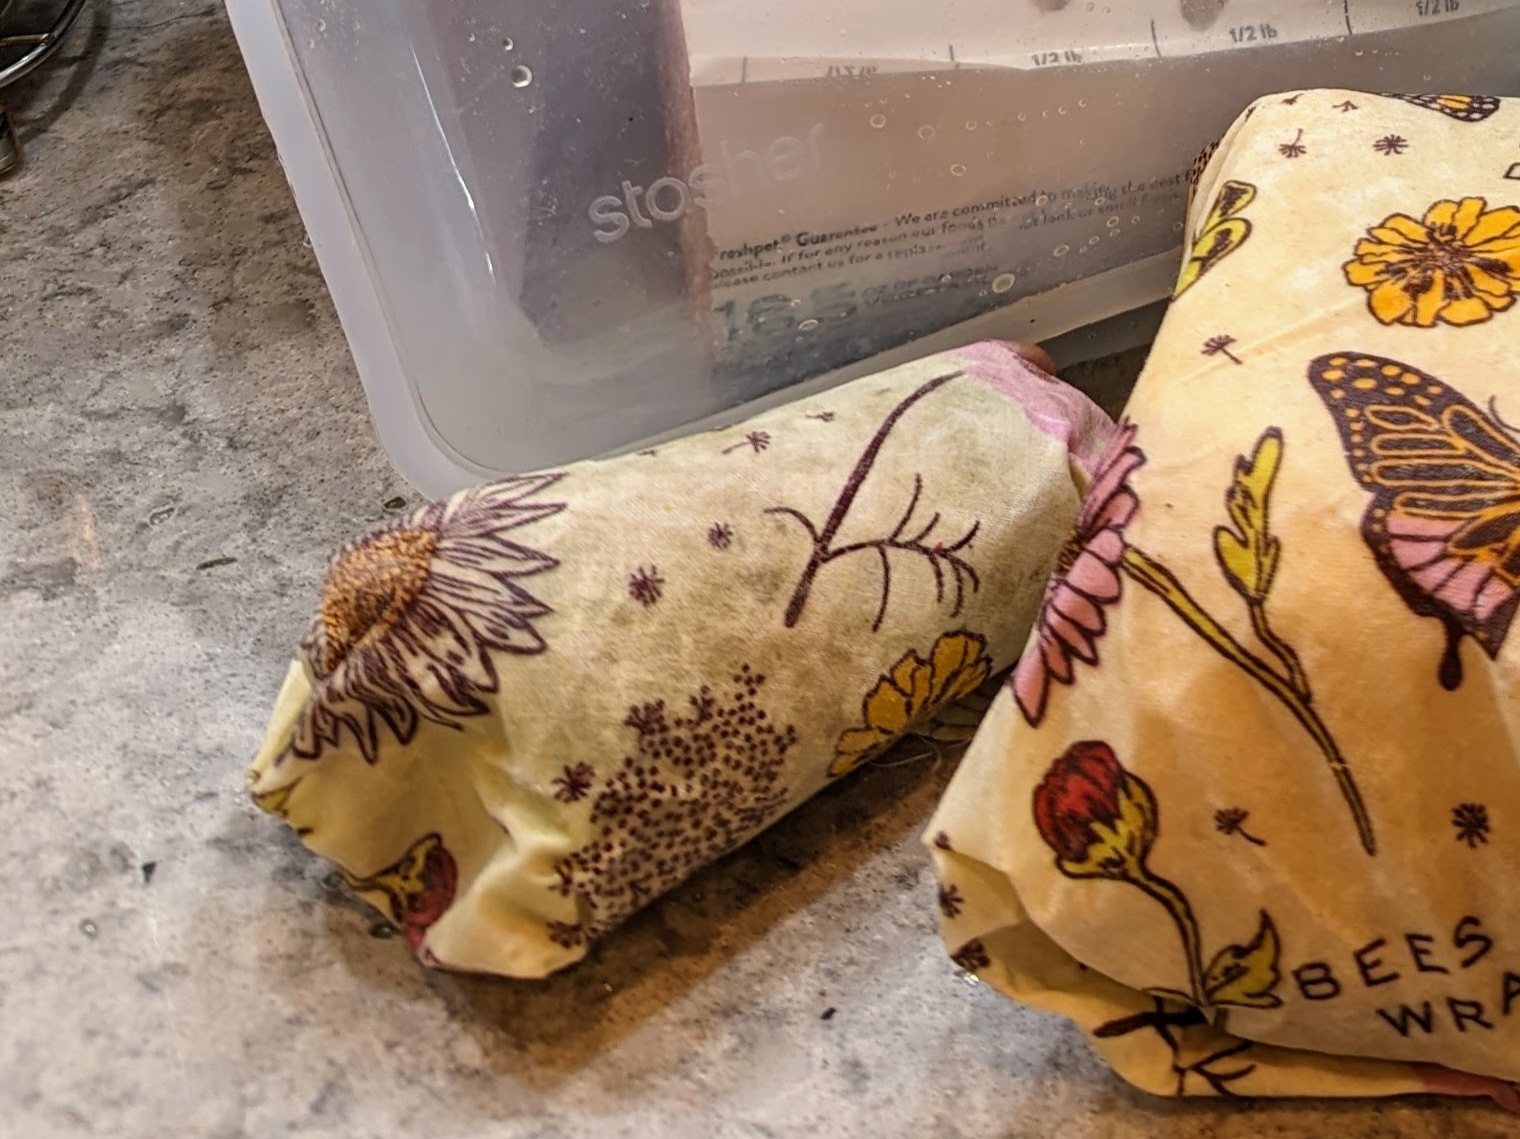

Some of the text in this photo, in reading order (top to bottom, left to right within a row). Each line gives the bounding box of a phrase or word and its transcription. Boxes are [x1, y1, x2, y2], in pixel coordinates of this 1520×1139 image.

[895, 212, 921, 227] We
[824, 241, 853, 259] any
[1293, 914, 1493, 1001] BEES
